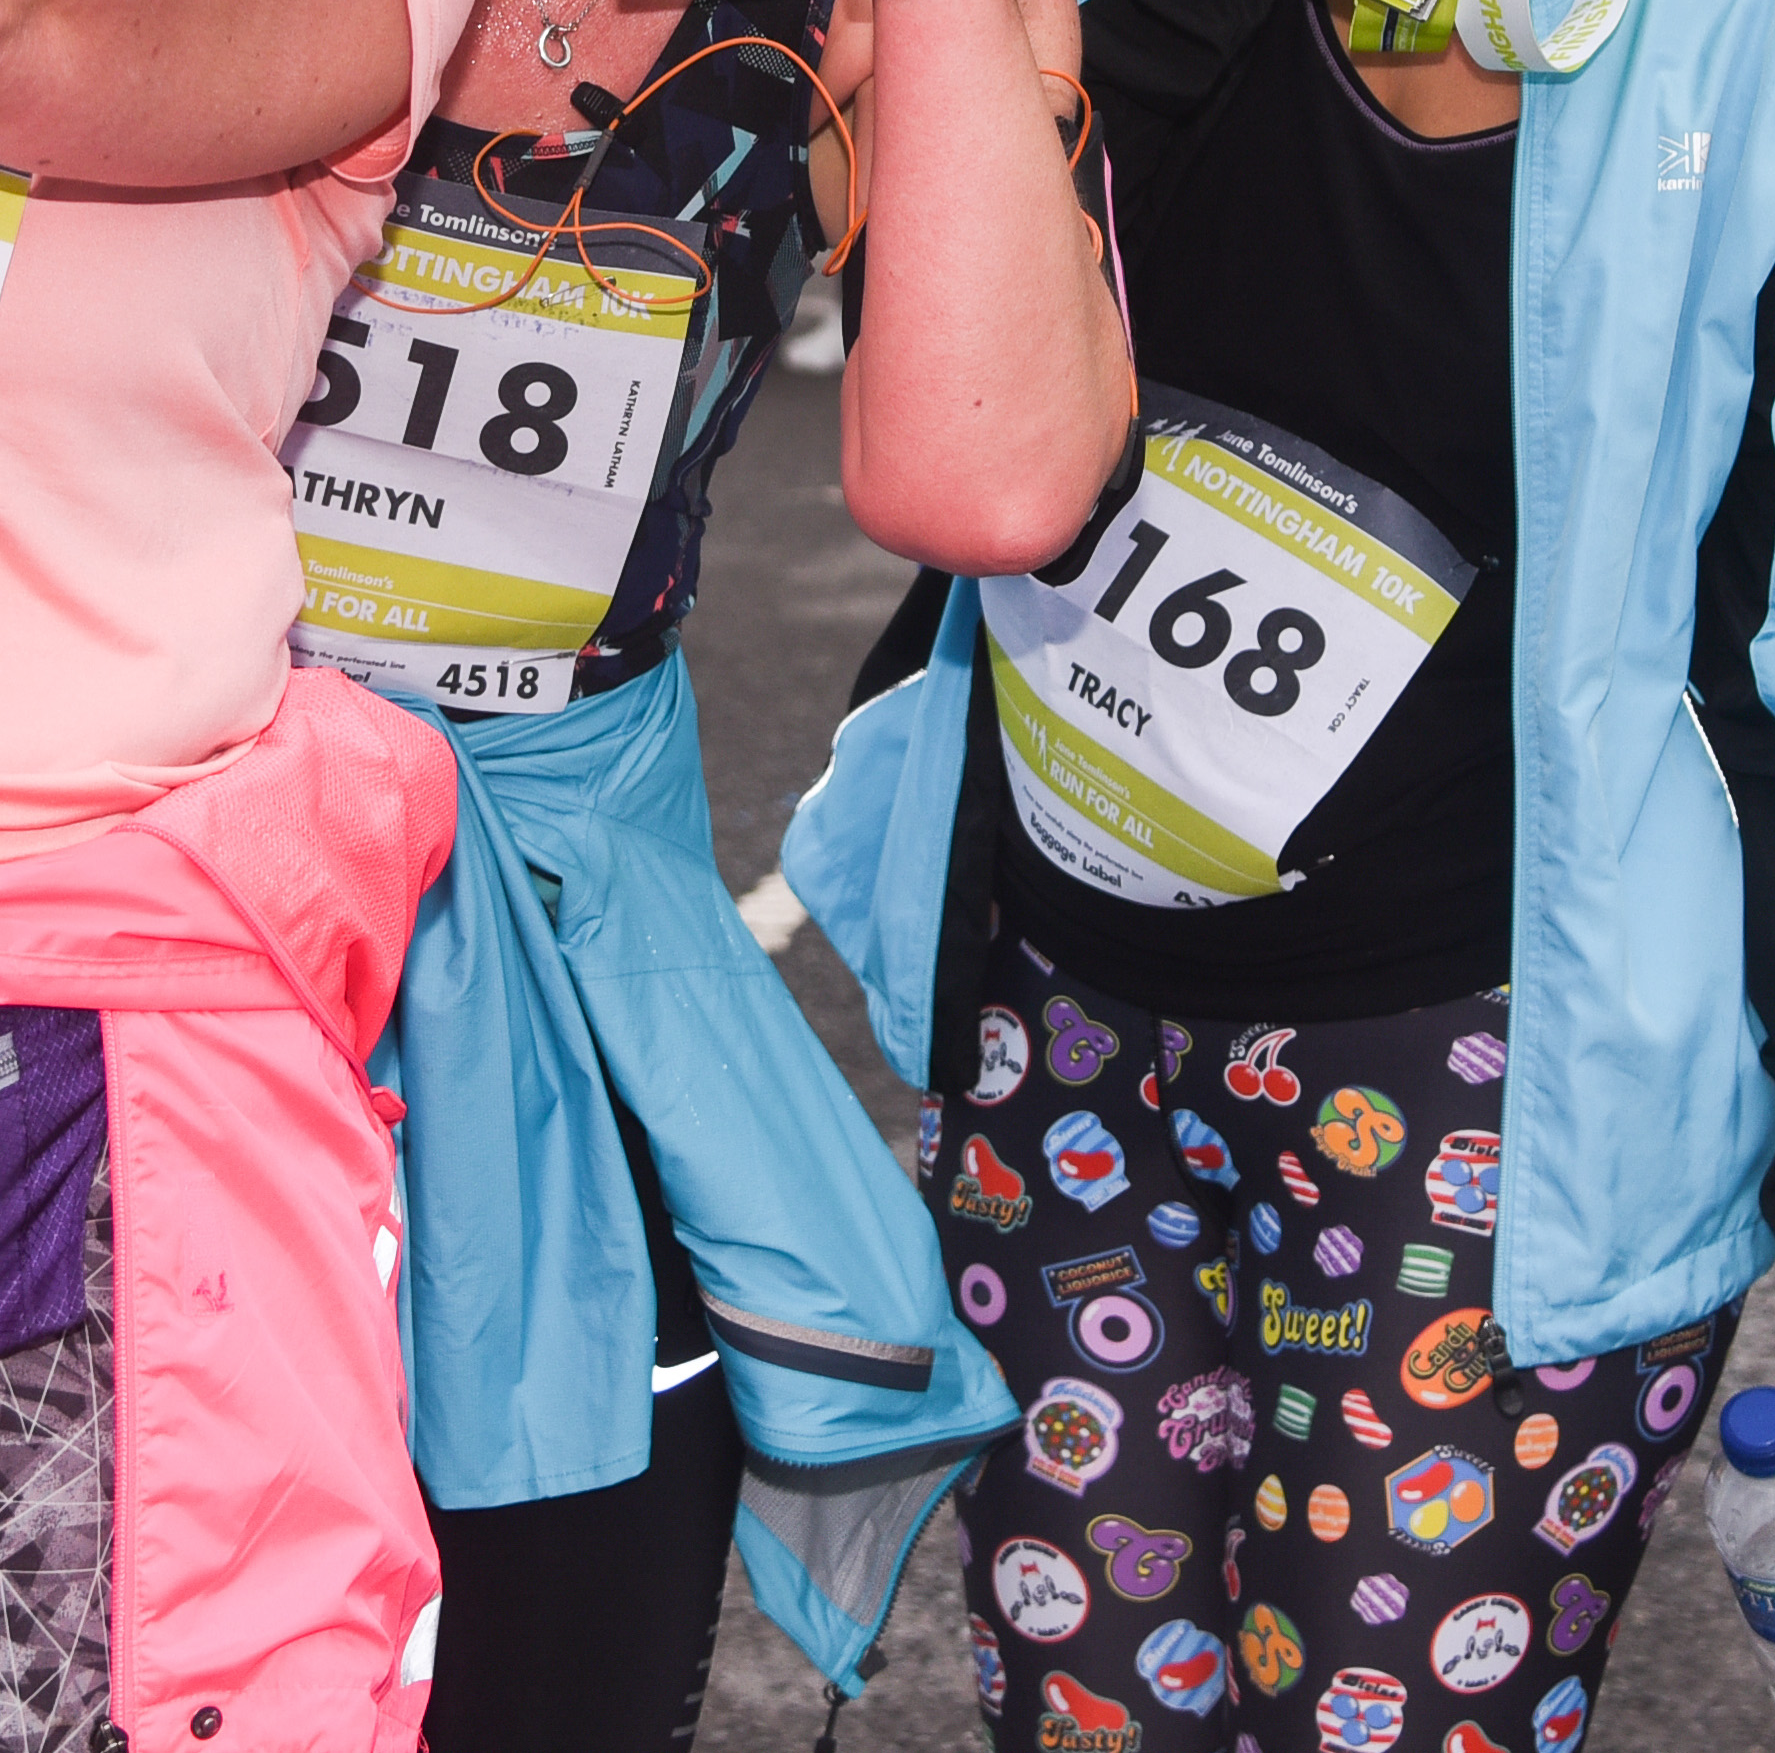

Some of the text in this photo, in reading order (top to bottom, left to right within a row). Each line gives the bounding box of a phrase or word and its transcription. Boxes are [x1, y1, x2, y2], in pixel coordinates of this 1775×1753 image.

[1657, 176, 1703, 192] karri
[374, 241, 586, 309] OTTINGHAM
[600, 288, 654, 321] 10K
[296, 314, 578, 476] 518
[604, 380, 641, 488] KATHRYN LATHAM
[1216, 430, 1360, 515] Jane Tomlinson's
[283, 465, 445, 529] THRYN
[1184, 455, 1425, 615] NOTTINGHAM 10K
[308, 559, 394, 589] Tomlinson's
[321, 591, 377, 623] FOR
[382, 606, 430, 633] ALL
[1093, 519, 1326, 717] 168
[319, 651, 333, 659] the
[337, 655, 386, 667] perforated
[390, 661, 406, 669] line
[437, 664, 539, 699] 4518
[1066, 662, 1153, 738] TRACY
[1345, 678, 1371, 711] TRACY
[1078, 754, 1131, 800] Tomlinson's
[1050, 759, 1084, 800] RUN
[1085, 789, 1120, 825] FOR
[1122, 815, 1154, 849] ALL
[1031, 811, 1121, 888] Baggage Label
[951, 1180, 1027, 1227] Tasty!
[1057, 1256, 1125, 1282] COCONUT
[1057, 1267, 1134, 1294] LIQUORICE
[1262, 1282, 1367, 1350] Sweet!
[1409, 1323, 1473, 1380] Candy
[1443, 1350, 1488, 1394] Cru
[1341, 1672, 1399, 1699] Divine
[1039, 1719, 1141, 1753] Tasty!
